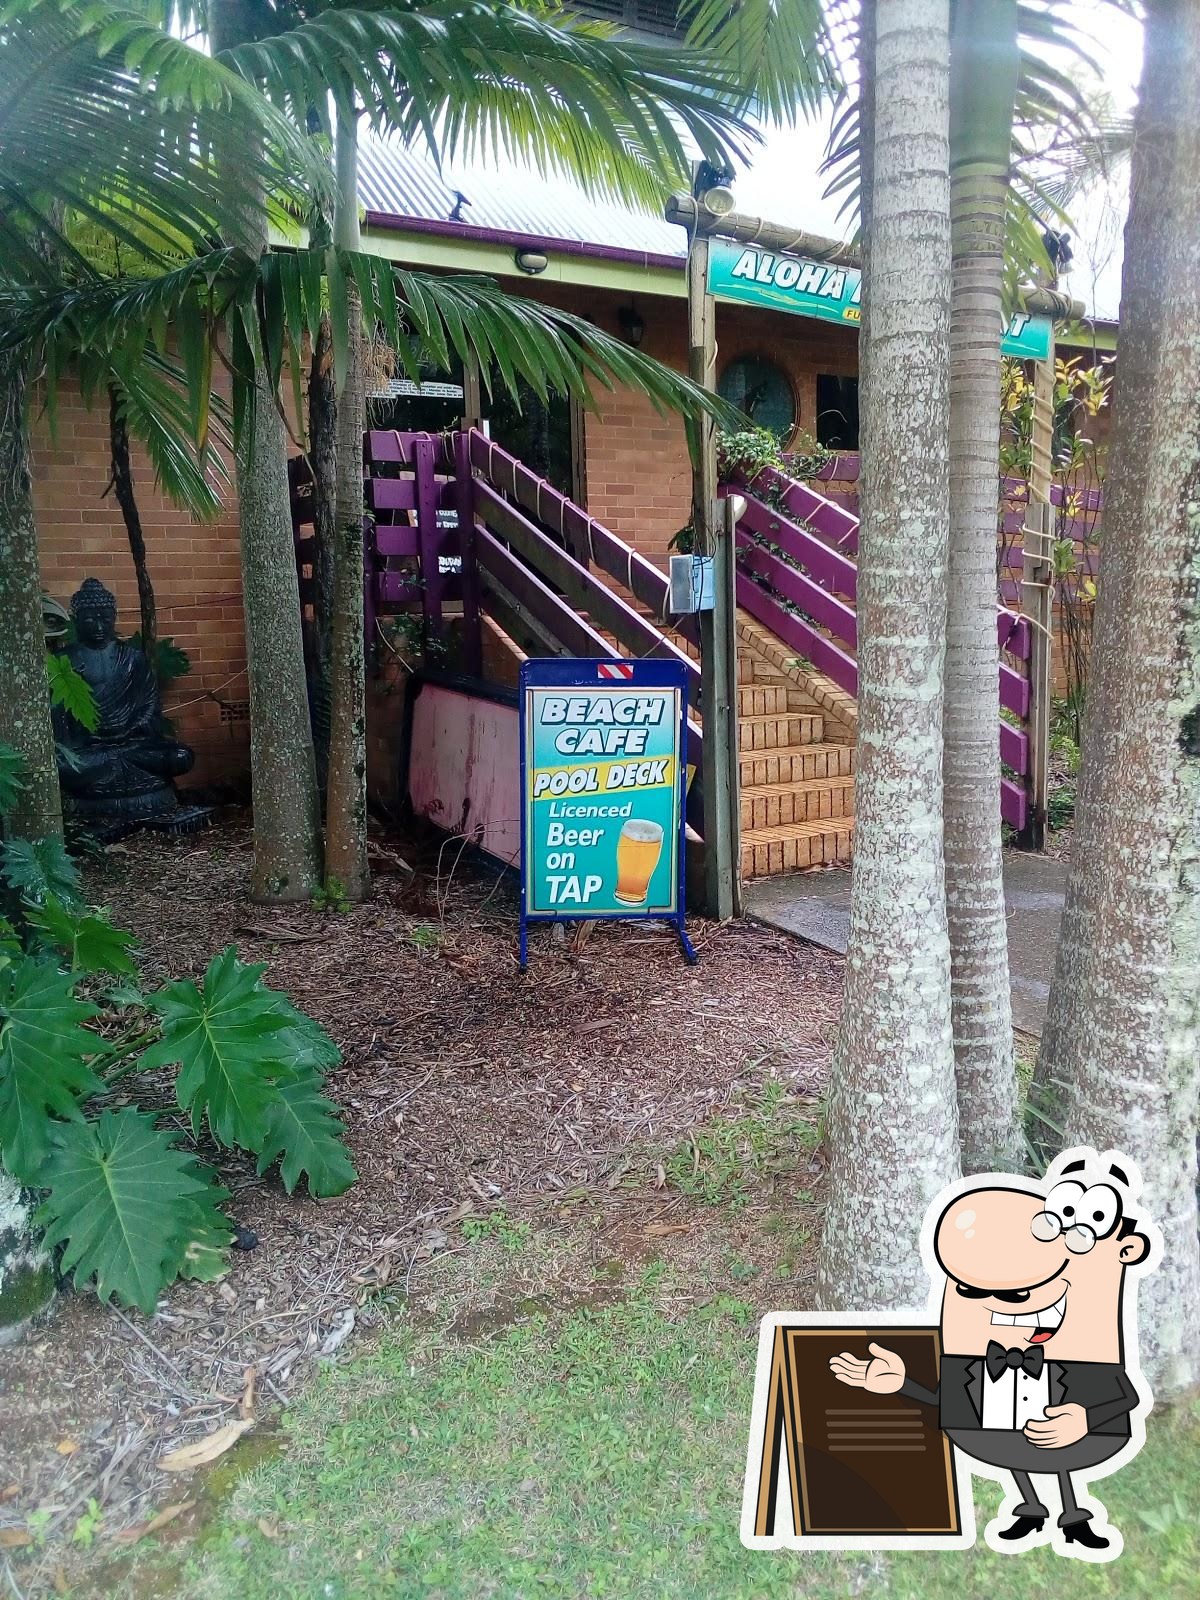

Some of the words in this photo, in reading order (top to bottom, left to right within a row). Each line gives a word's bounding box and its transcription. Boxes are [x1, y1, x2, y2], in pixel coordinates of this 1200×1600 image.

[731, 249, 847, 300] ALOHA
[1003, 311, 1032, 337] T
[846, 309, 861, 320] FU
[540, 697, 665, 725] BEACH
[554, 728, 649, 756] CAFE
[533, 767, 599, 798] POOL
[605, 759, 670, 790] DECK
[548, 802, 633, 818] Licenced
[546, 822, 605, 847] Beer
[546, 852, 575, 870] on
[545, 875, 603, 904] TAP
